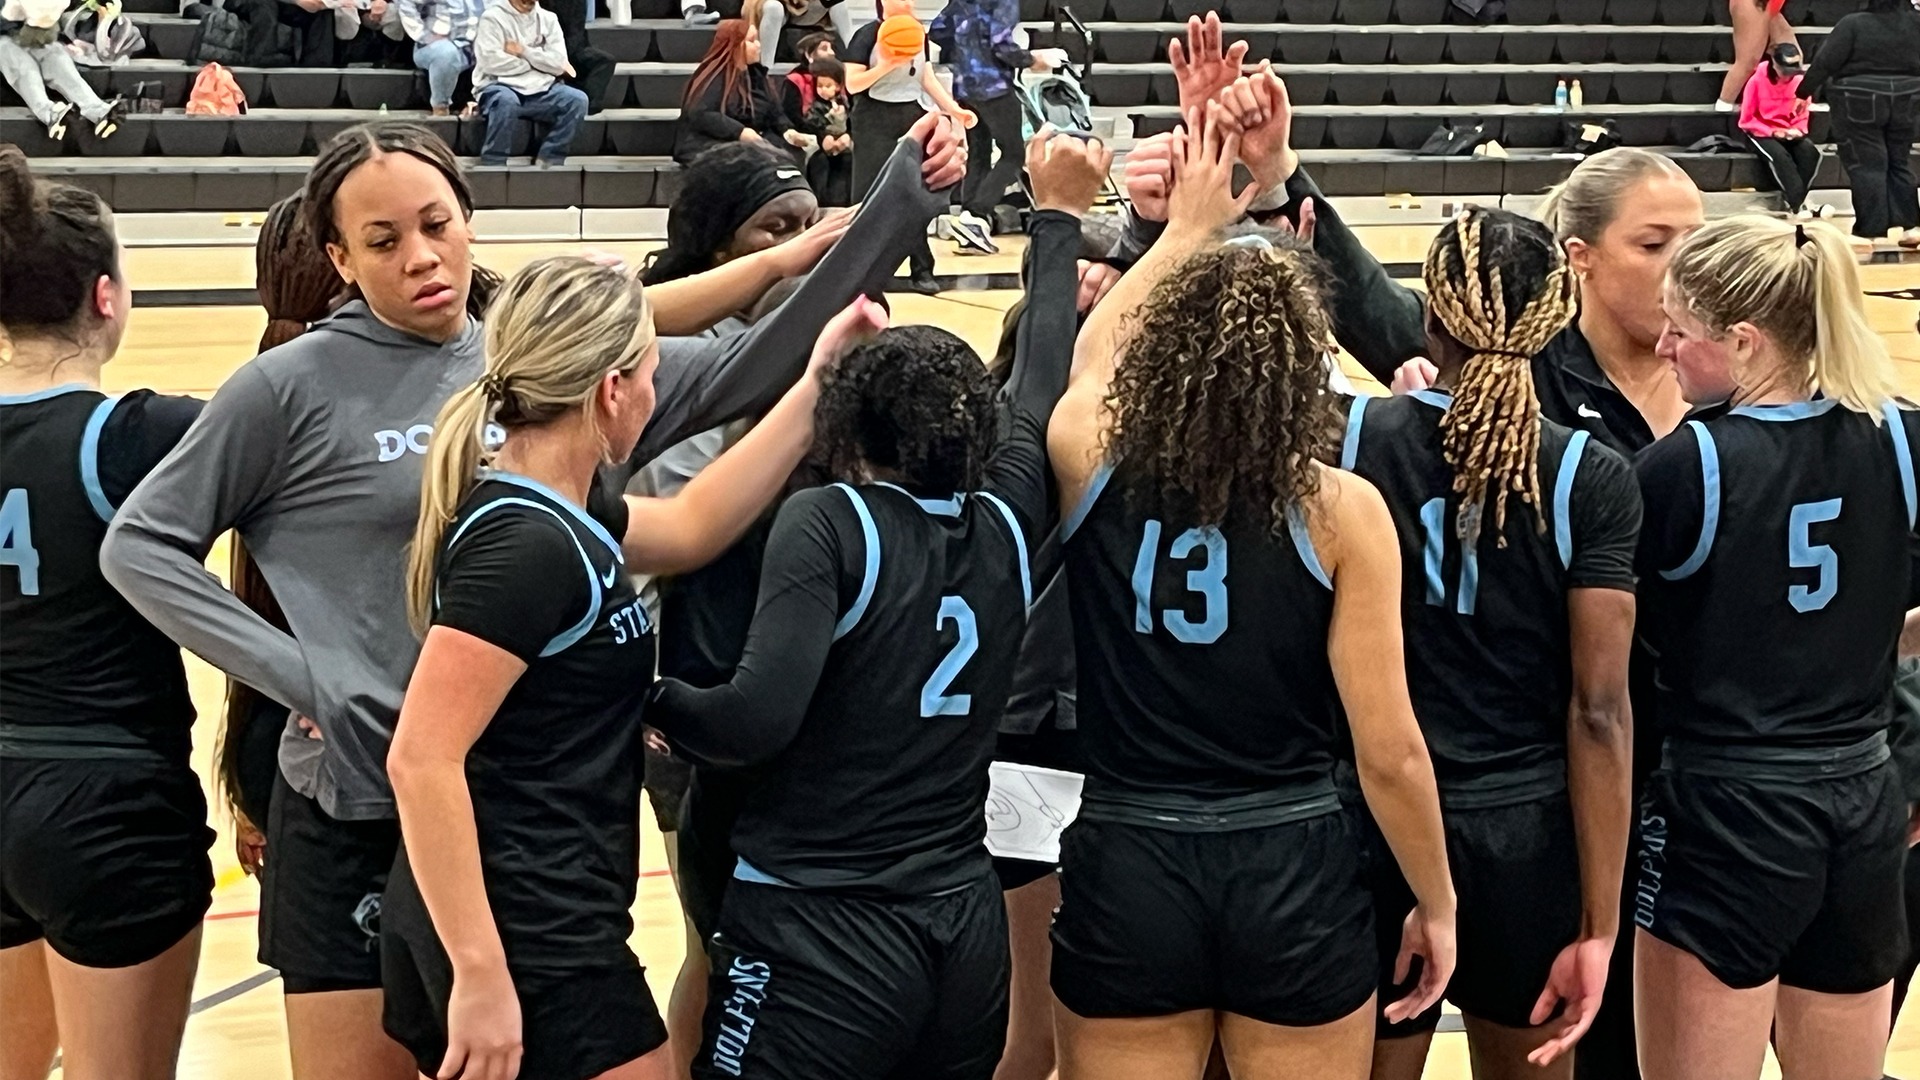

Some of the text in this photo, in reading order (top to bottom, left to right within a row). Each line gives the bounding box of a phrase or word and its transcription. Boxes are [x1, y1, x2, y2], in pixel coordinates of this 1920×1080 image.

[0, 487, 40, 596] 4
[1131, 518, 1229, 645] 13
[1420, 496, 1479, 616] 11
[1787, 497, 1842, 613] 5
[920, 595, 979, 718] 2
